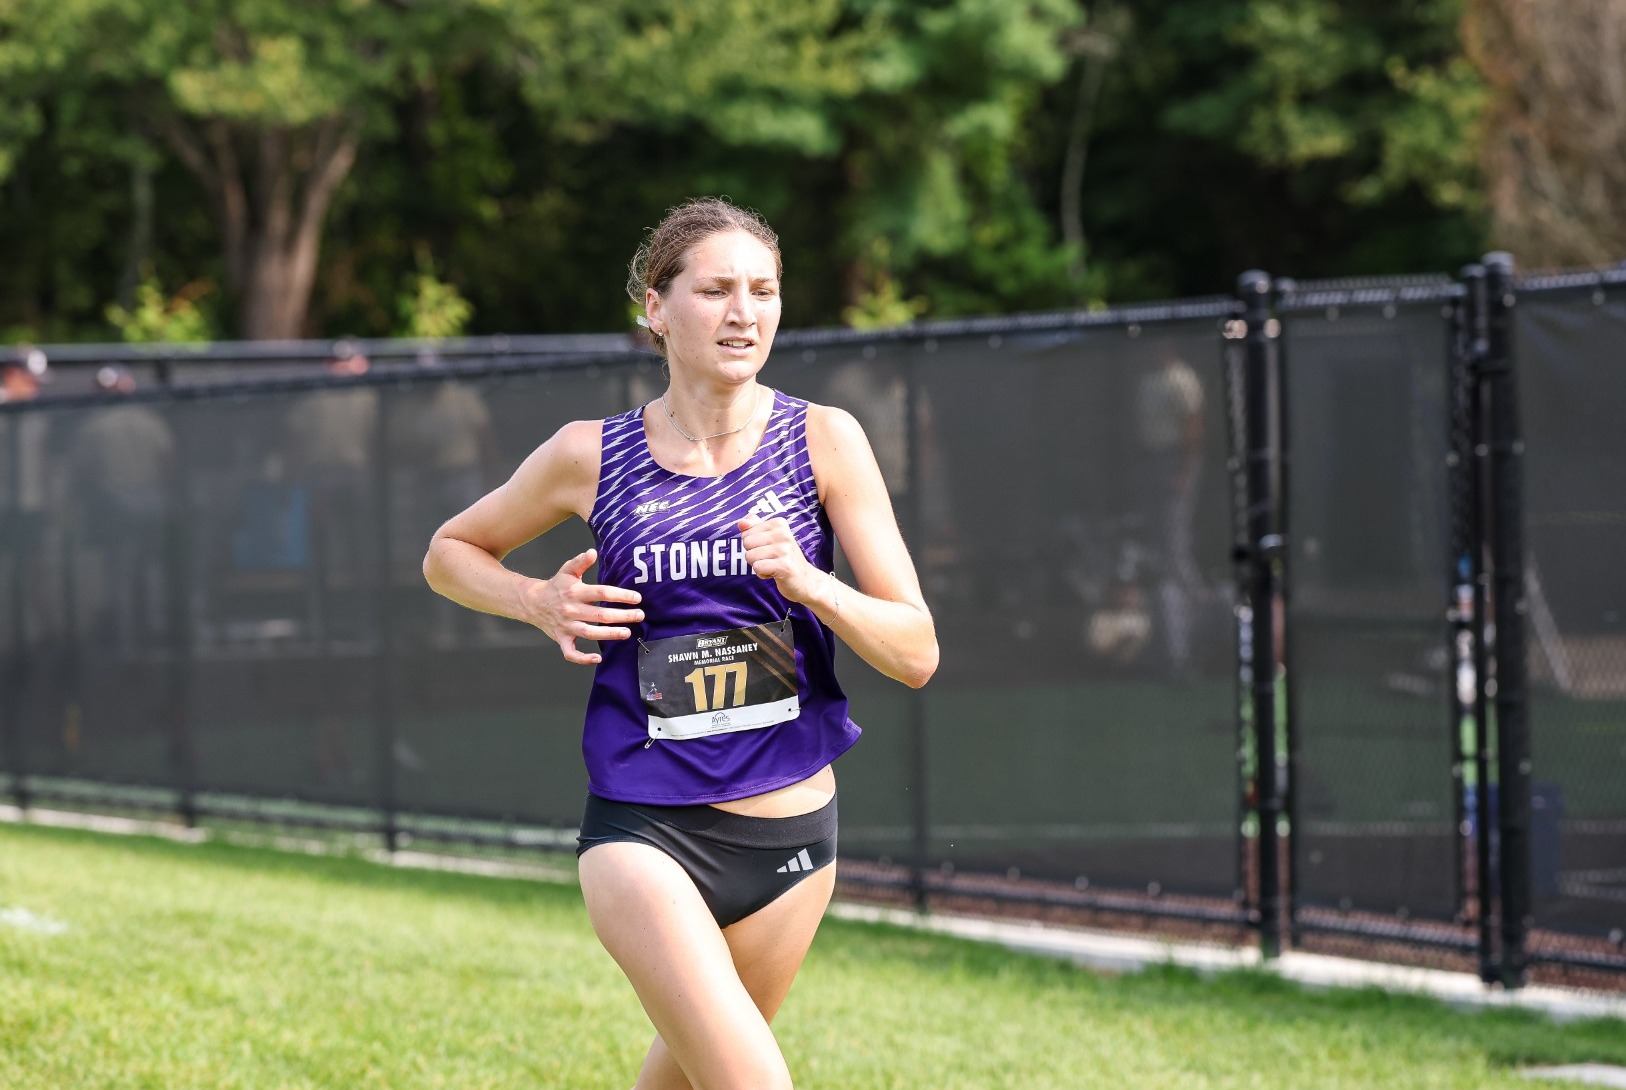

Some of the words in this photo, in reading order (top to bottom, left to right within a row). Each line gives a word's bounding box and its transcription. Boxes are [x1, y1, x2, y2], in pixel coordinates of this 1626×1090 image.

[634, 500, 670, 516] NEC
[633, 538, 757, 584] STONEH
[697, 636, 728, 649] BRYANT
[668, 651, 699, 663] SHAWN
[701, 650, 712, 659] M.
[715, 643, 758, 656] NASSANEY
[694, 657, 721, 665] MEMORIAL
[685, 661, 747, 712] 177
